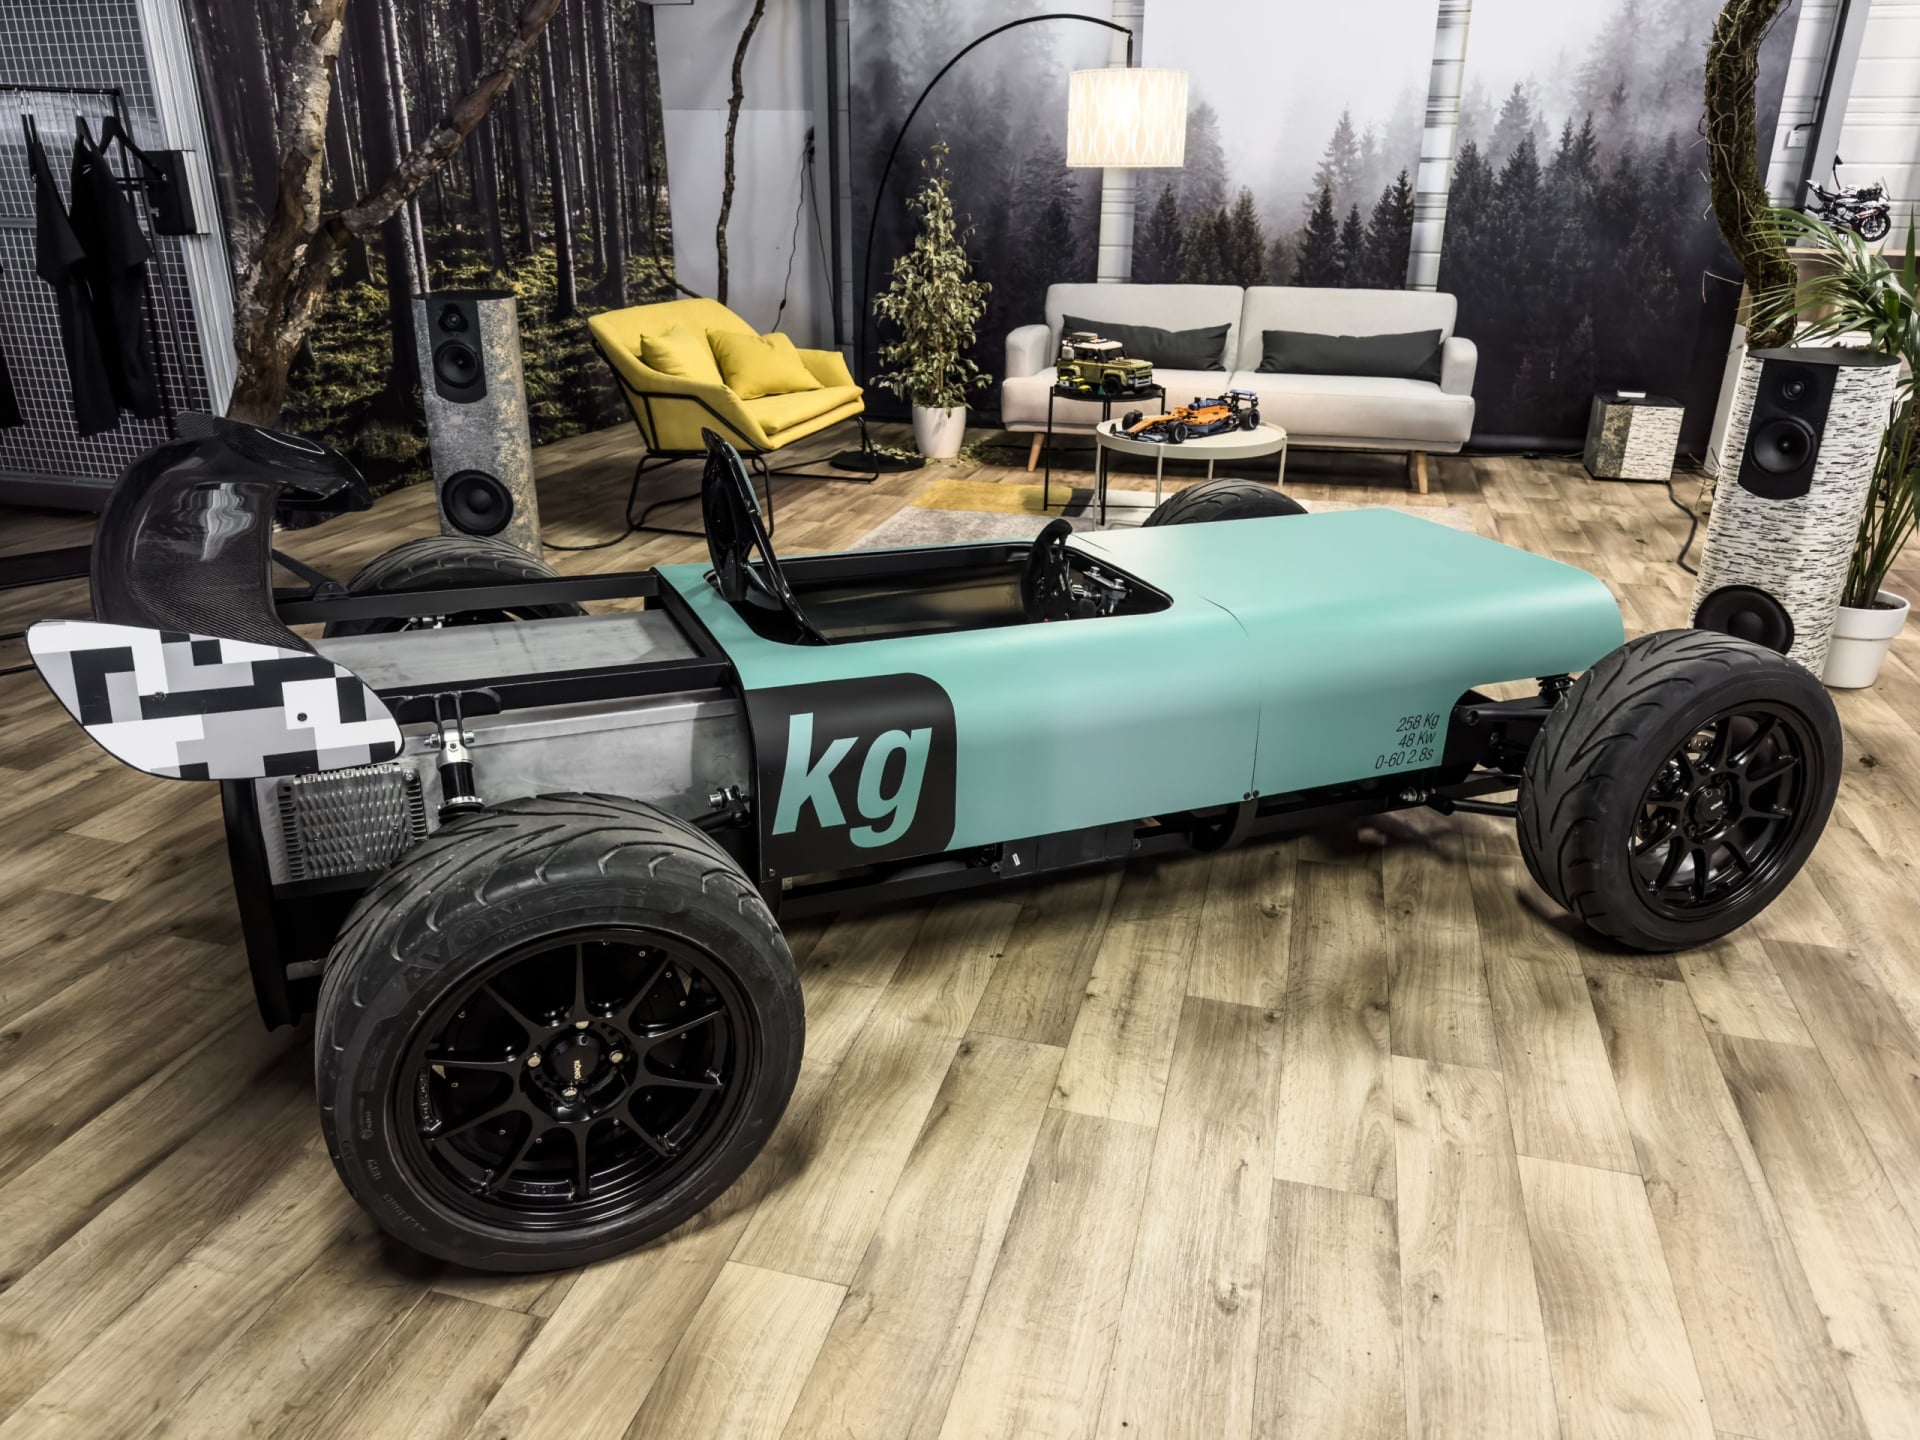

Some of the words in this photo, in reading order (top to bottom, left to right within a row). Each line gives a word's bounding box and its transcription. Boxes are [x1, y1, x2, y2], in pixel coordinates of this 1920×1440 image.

[1396, 714, 1422, 732] 258
[1423, 712, 1440, 730] Kg
[1398, 732, 1416, 748] 48
[1375, 751, 1405, 769] 0-60
[1406, 747, 1434, 765] 2.8s
[772, 712, 932, 848] kg
